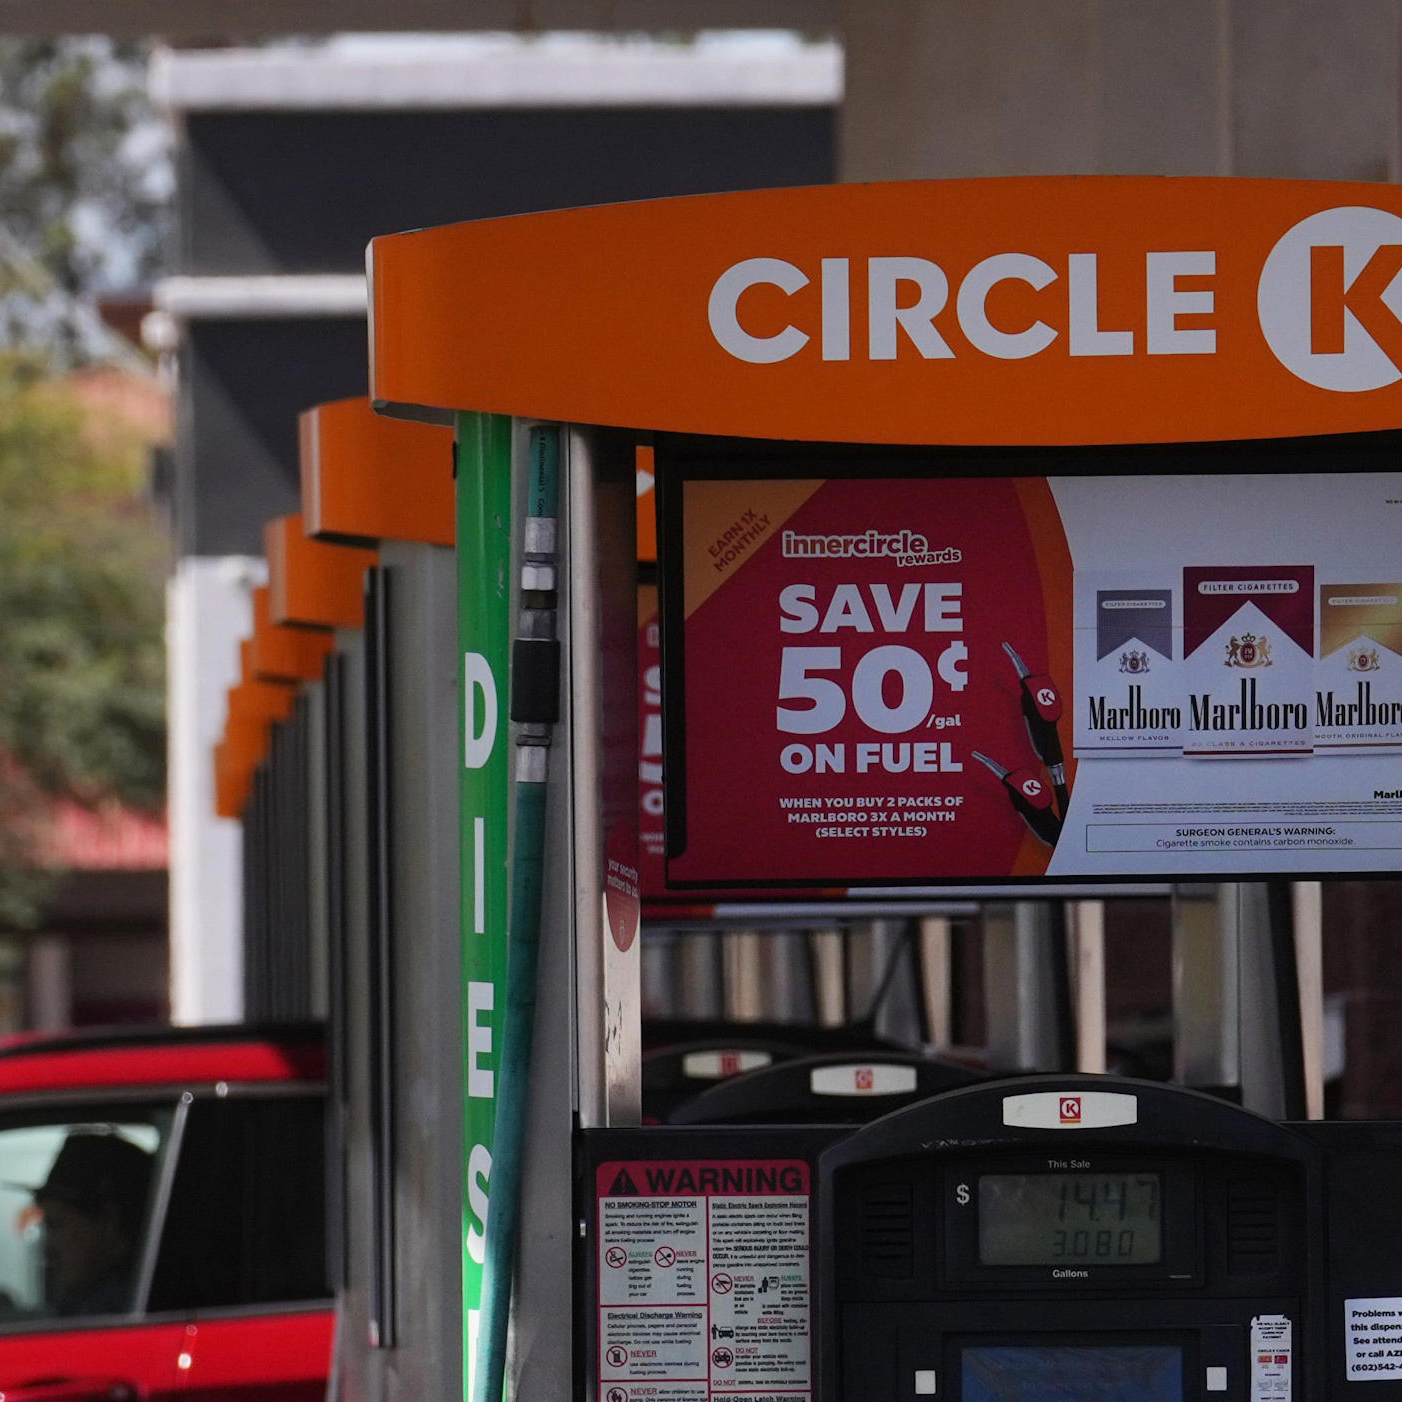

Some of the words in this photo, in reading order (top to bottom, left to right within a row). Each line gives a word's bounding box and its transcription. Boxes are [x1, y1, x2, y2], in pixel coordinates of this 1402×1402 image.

[707, 251, 1218, 364] CIRCLE
[708, 522, 743, 558] EARN
[741, 509, 757, 524] 1X
[714, 514, 770, 572] MONTHLY
[783, 531, 928, 557] innercircle
[898, 548, 961, 566] rewards
[1204, 584, 1234, 592] FILTER
[1238, 583, 1294, 591] CIGARETTES
[779, 582, 963, 633] SAVE
[1088, 685, 1181, 730] Marlboro
[1189, 678, 1307, 731] Marlboro
[926, 715, 961, 728] /gal
[780, 743, 844, 774] ON
[856, 742, 963, 773] FUEL
[780, 798, 821, 808] WHEN
[825, 798, 854, 808] YOU
[857, 798, 883, 808] BUY
[886, 798, 895, 807] 2
[898, 797, 940, 807] PACKS
[943, 797, 963, 806] OF
[788, 813, 867, 823] MARLBORO
[870, 812, 887, 822] 3X
[890, 812, 900, 822] A
[903, 812, 955, 822] MONTH
[816, 827, 869, 838] (SELECT
[872, 826, 927, 837] STYLES)
[1176, 828, 1225, 837] SURGEON
[1284, 827, 1336, 836] WARNING:
[1156, 839, 1198, 849] Cigarette
[1201, 838, 1230, 847] smoke
[1233, 838, 1271, 847] contains
[1274, 838, 1305, 846] carbon
[607, 858, 619, 872] your
[619, 864, 638, 884] security
[607, 876, 625, 892] matters
[626, 883, 631, 895] to
[1048, 1160, 1068, 1168] This
[1070, 1160, 1090, 1168] Sale
[646, 1167, 802, 1193] WARNING
[956, 1184, 970, 1205] $
[1052, 1269, 1088, 1278] Gallons
